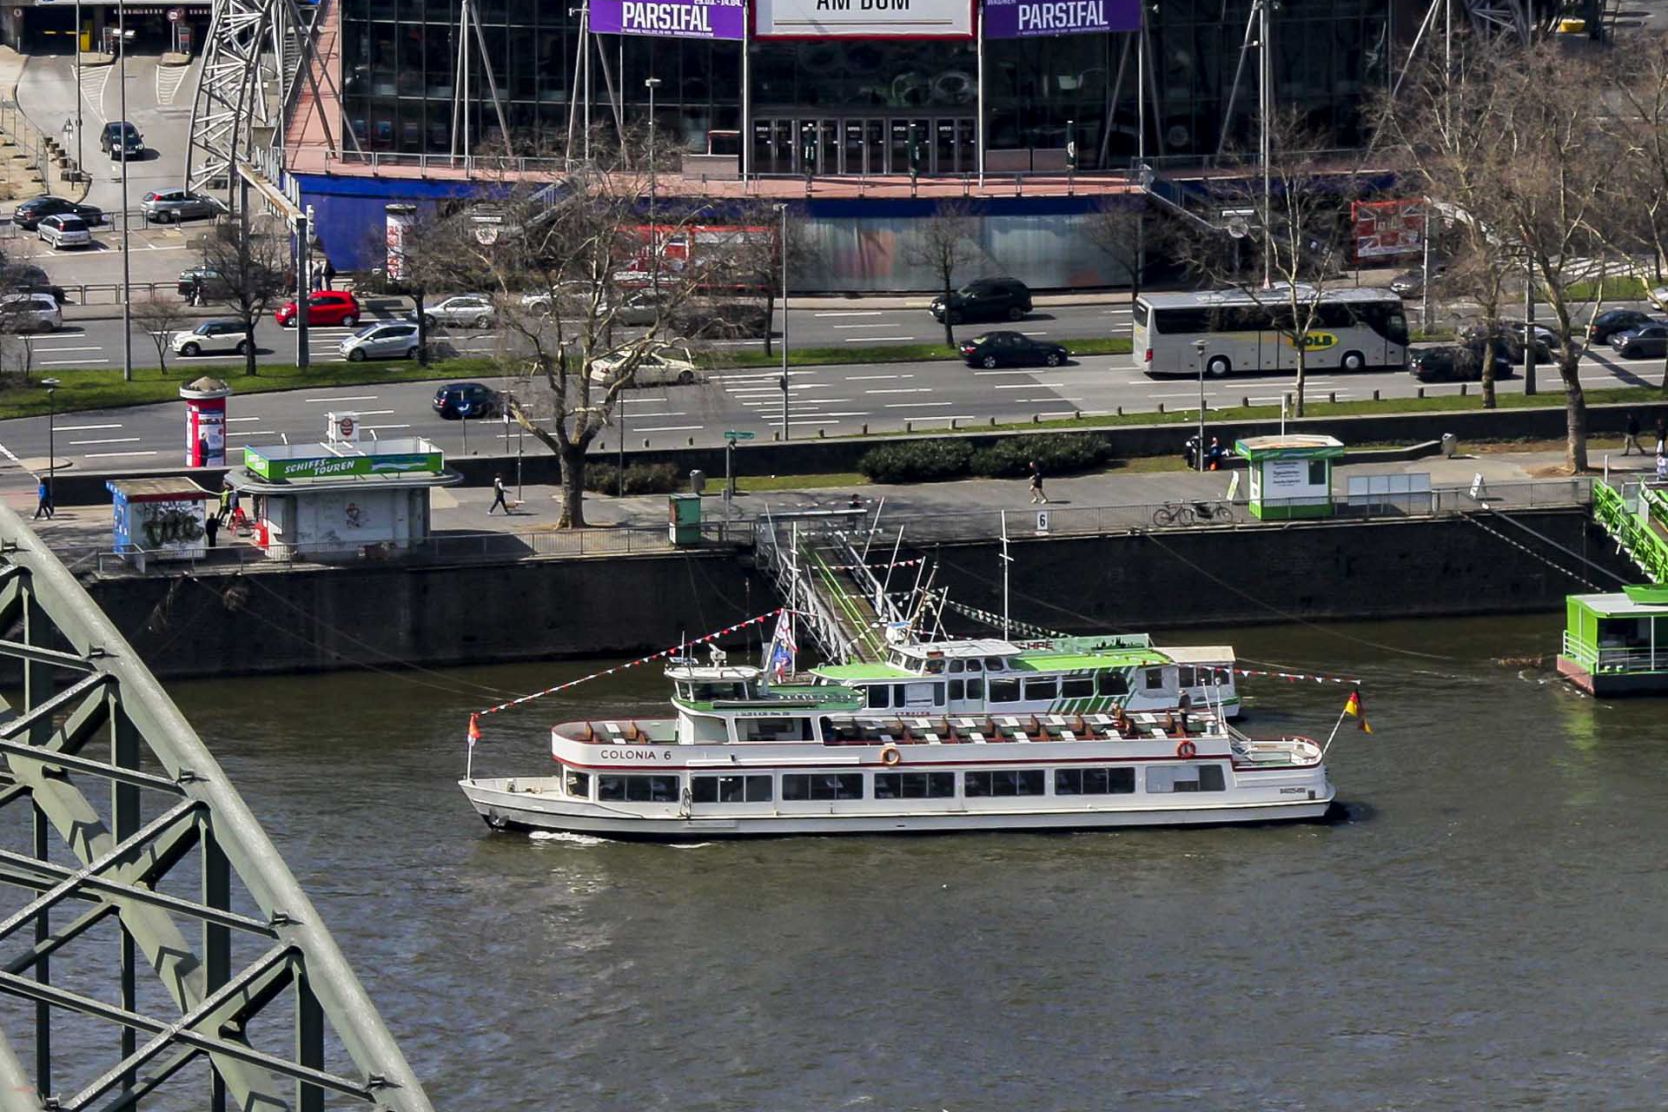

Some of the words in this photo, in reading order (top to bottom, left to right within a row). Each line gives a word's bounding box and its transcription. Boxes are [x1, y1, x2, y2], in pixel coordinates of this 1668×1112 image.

[622, 1, 713, 32] PARSIFAL
[1018, 0, 1109, 30] PARSIFAL
[284, 458, 331, 474] SCHIFFS-
[314, 460, 355, 476] TOUREN
[1039, 513, 1046, 527] 6
[600, 750, 657, 760] COLONIA
[663, 750, 672, 760] 6
